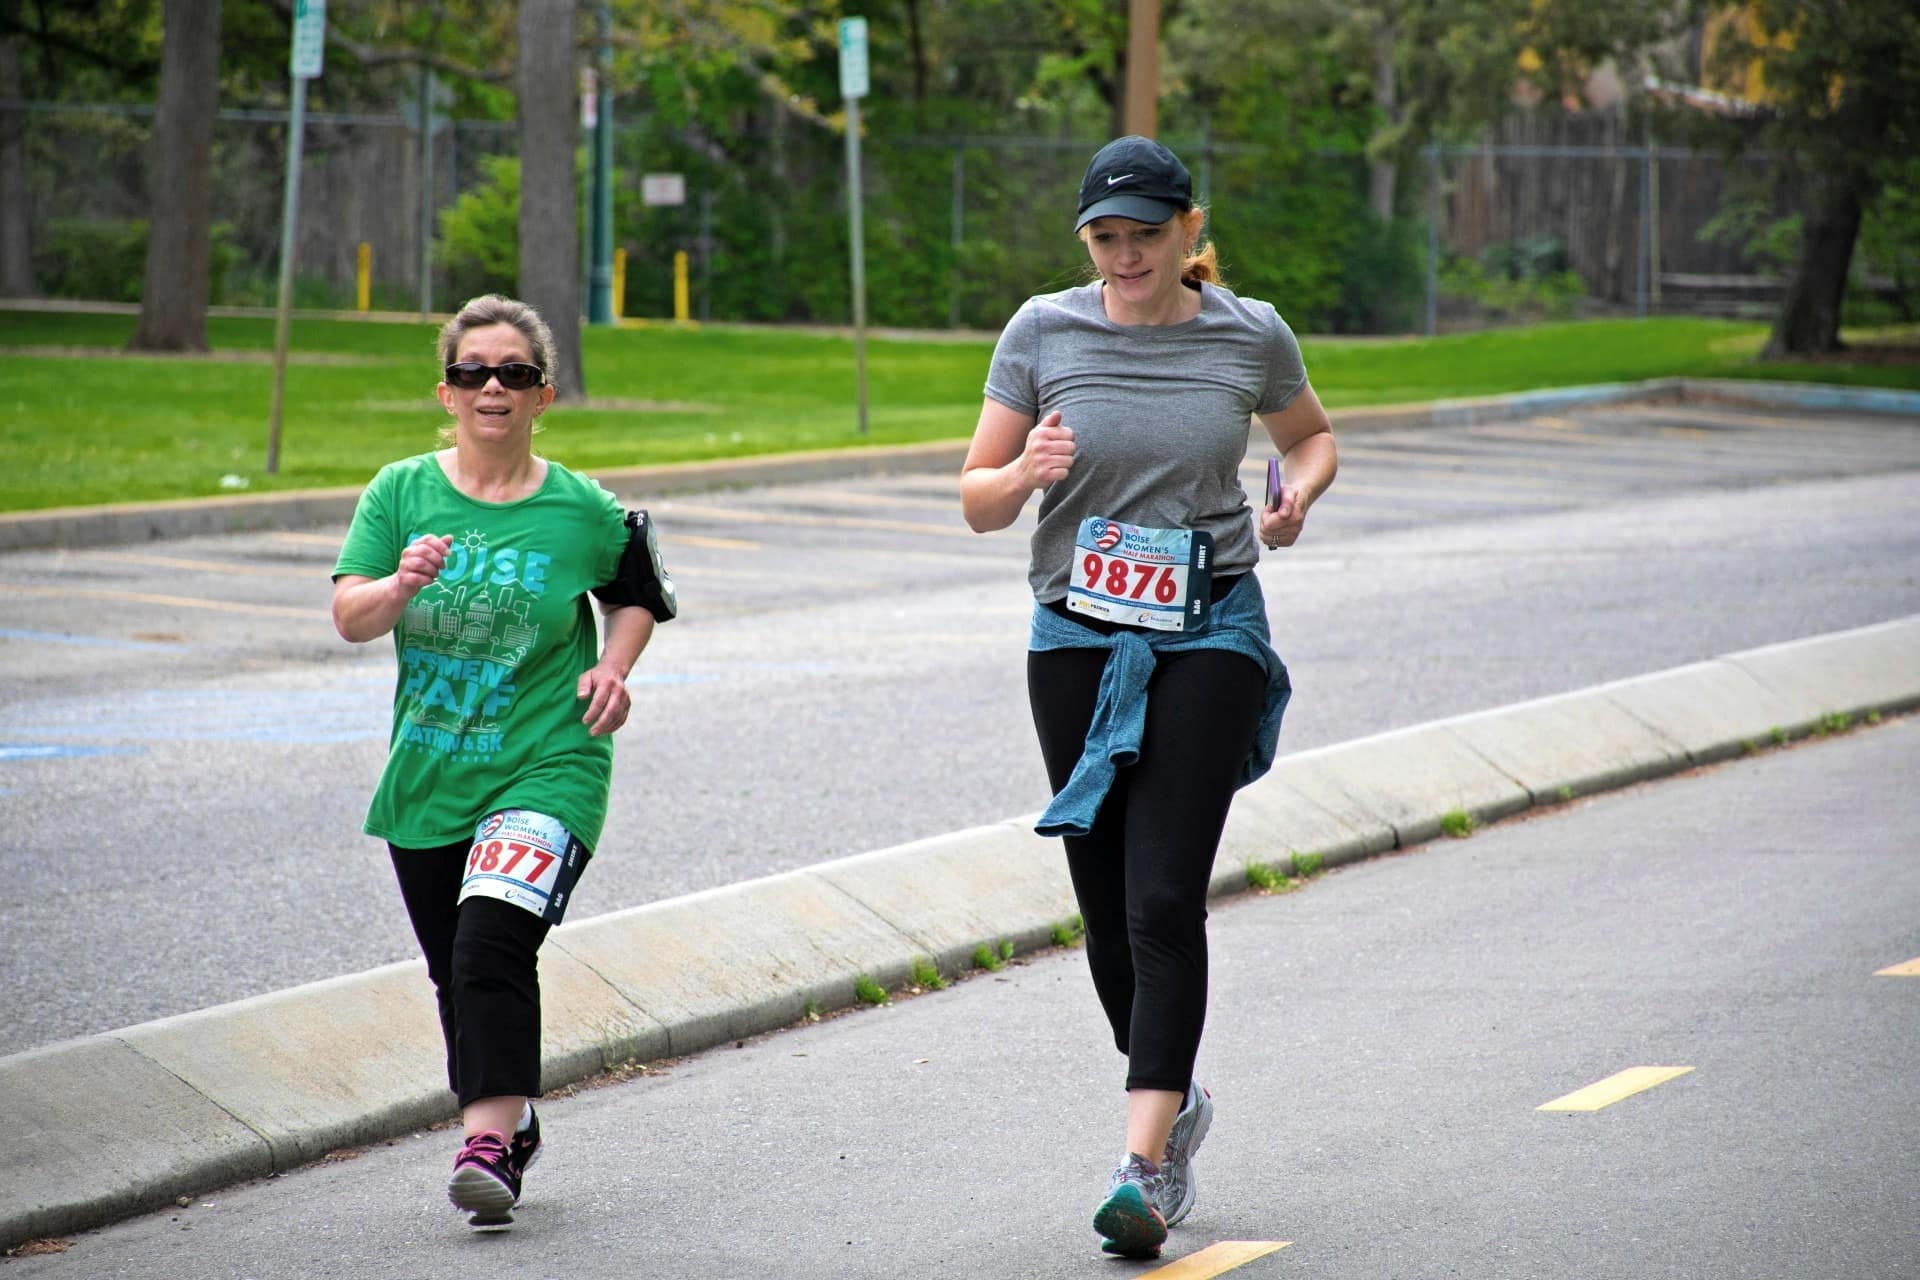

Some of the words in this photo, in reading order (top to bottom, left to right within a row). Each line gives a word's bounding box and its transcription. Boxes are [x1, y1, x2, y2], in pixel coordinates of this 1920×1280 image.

[1124, 541, 1169, 554] WOMEN'S
[1125, 533, 1150, 544] BOISE
[408, 532, 551, 593] OISE
[1198, 545, 1206, 569] SHIRT
[1083, 553, 1177, 604] 9876
[477, 733, 505, 753] 5K
[507, 816, 529, 826] BOISE
[504, 823, 548, 840] WOMEN'S
[468, 840, 555, 884] 9877
